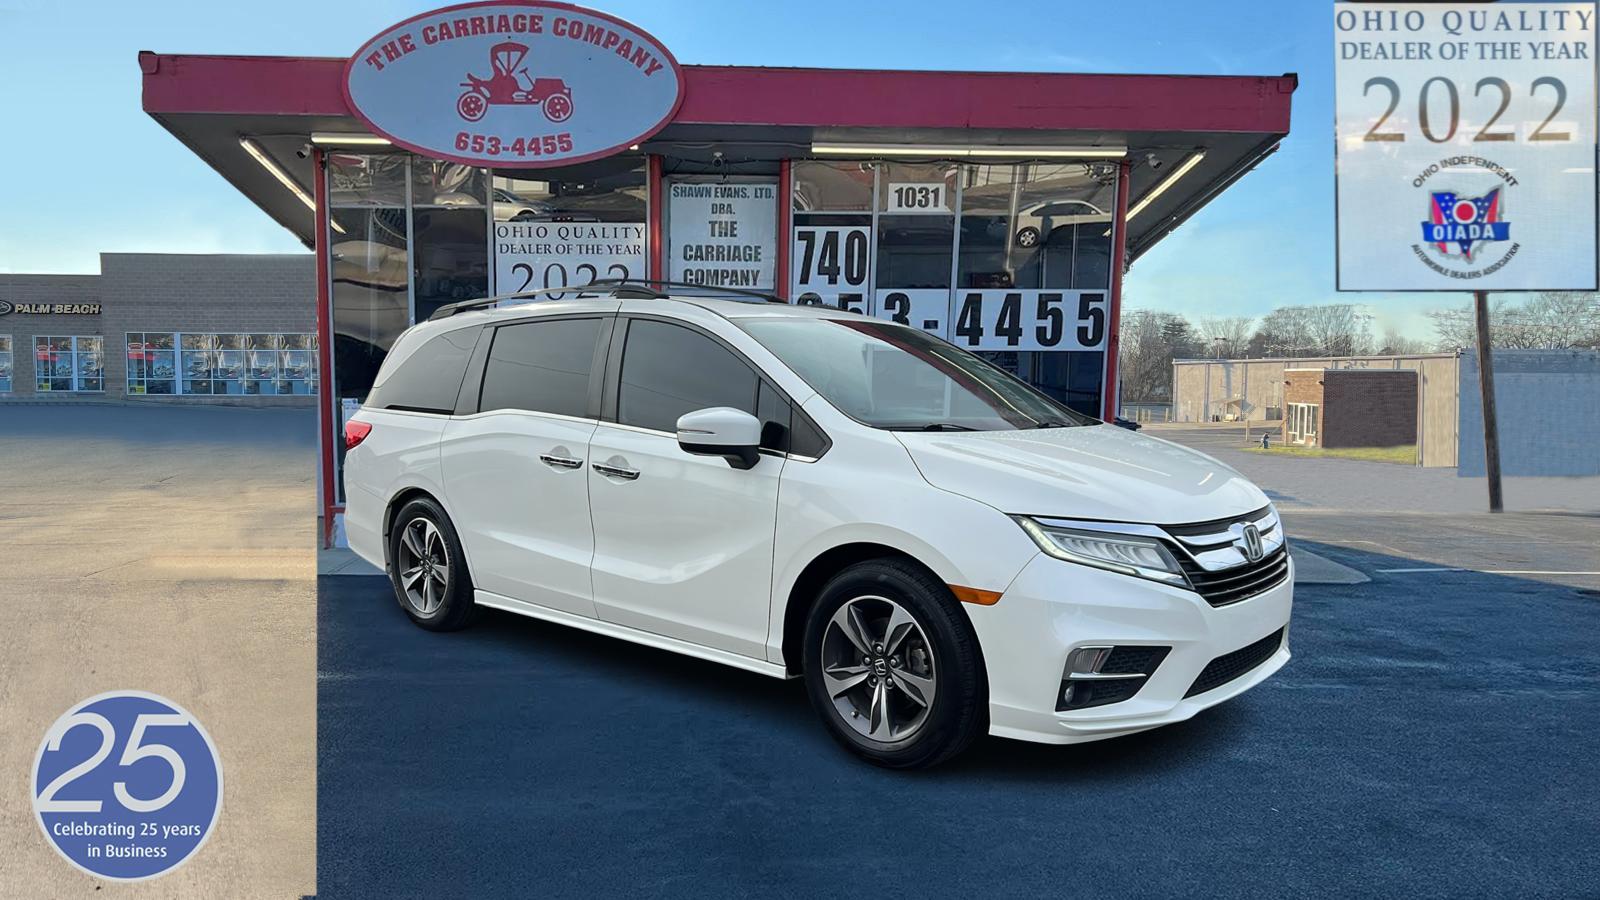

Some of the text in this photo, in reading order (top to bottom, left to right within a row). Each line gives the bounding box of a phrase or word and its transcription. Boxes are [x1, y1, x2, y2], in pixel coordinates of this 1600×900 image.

[1336, 10, 1593, 36] OHIO QUALITY
[365, 14, 664, 77] THE CARRIAGE COMPANY
[1340, 42, 1589, 60] DEALER OF THE YEAR
[1362, 76, 1571, 144] 2022
[454, 132, 573, 156] 653-4455
[1412, 155, 1519, 188] OHIO INDEPENDENT
[673, 186, 712, 198] SHAWN
[754, 187, 775, 199] LTD.
[894, 187, 940, 208] 1031
[711, 203, 736, 215] DBA.
[497, 226, 645, 241] OHIO QUALITY
[709, 221, 738, 237] THE
[1432, 225, 1496, 240] OIADA
[499, 243, 641, 255] DEALER OF THE YEAR
[683, 244, 762, 262] CARRIAGE
[797, 230, 868, 286] 740
[683, 269, 761, 286] COMPANY
[14, 303, 101, 314] PALM BEACH
